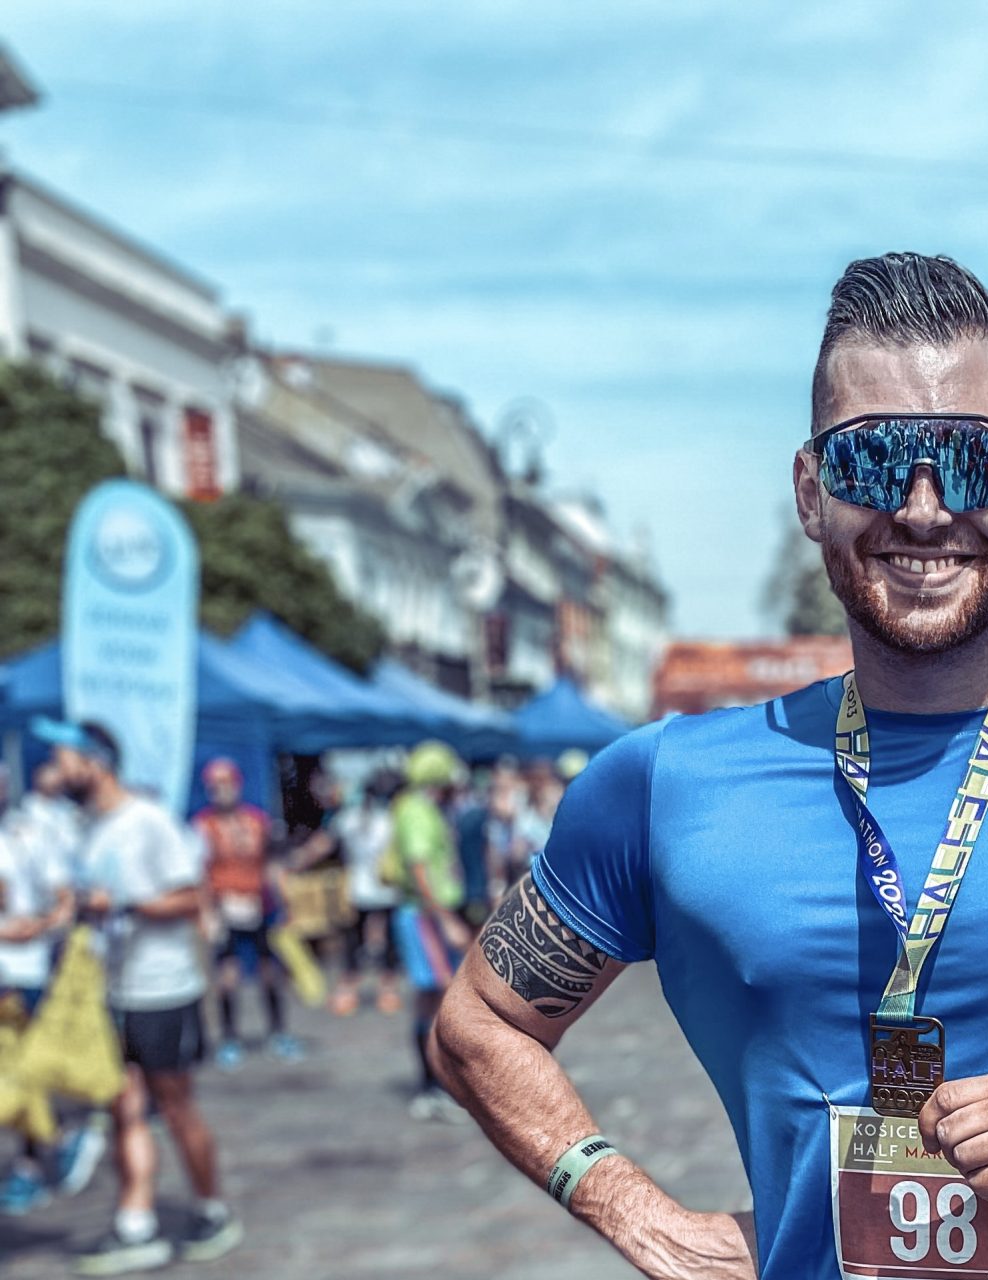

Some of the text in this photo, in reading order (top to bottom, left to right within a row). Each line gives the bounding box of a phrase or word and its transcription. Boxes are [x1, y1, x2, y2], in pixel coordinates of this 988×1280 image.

[853, 1122, 918, 1139] KOŠICE
[853, 1142, 899, 1158] HALF
[889, 1180, 978, 1265] 98
